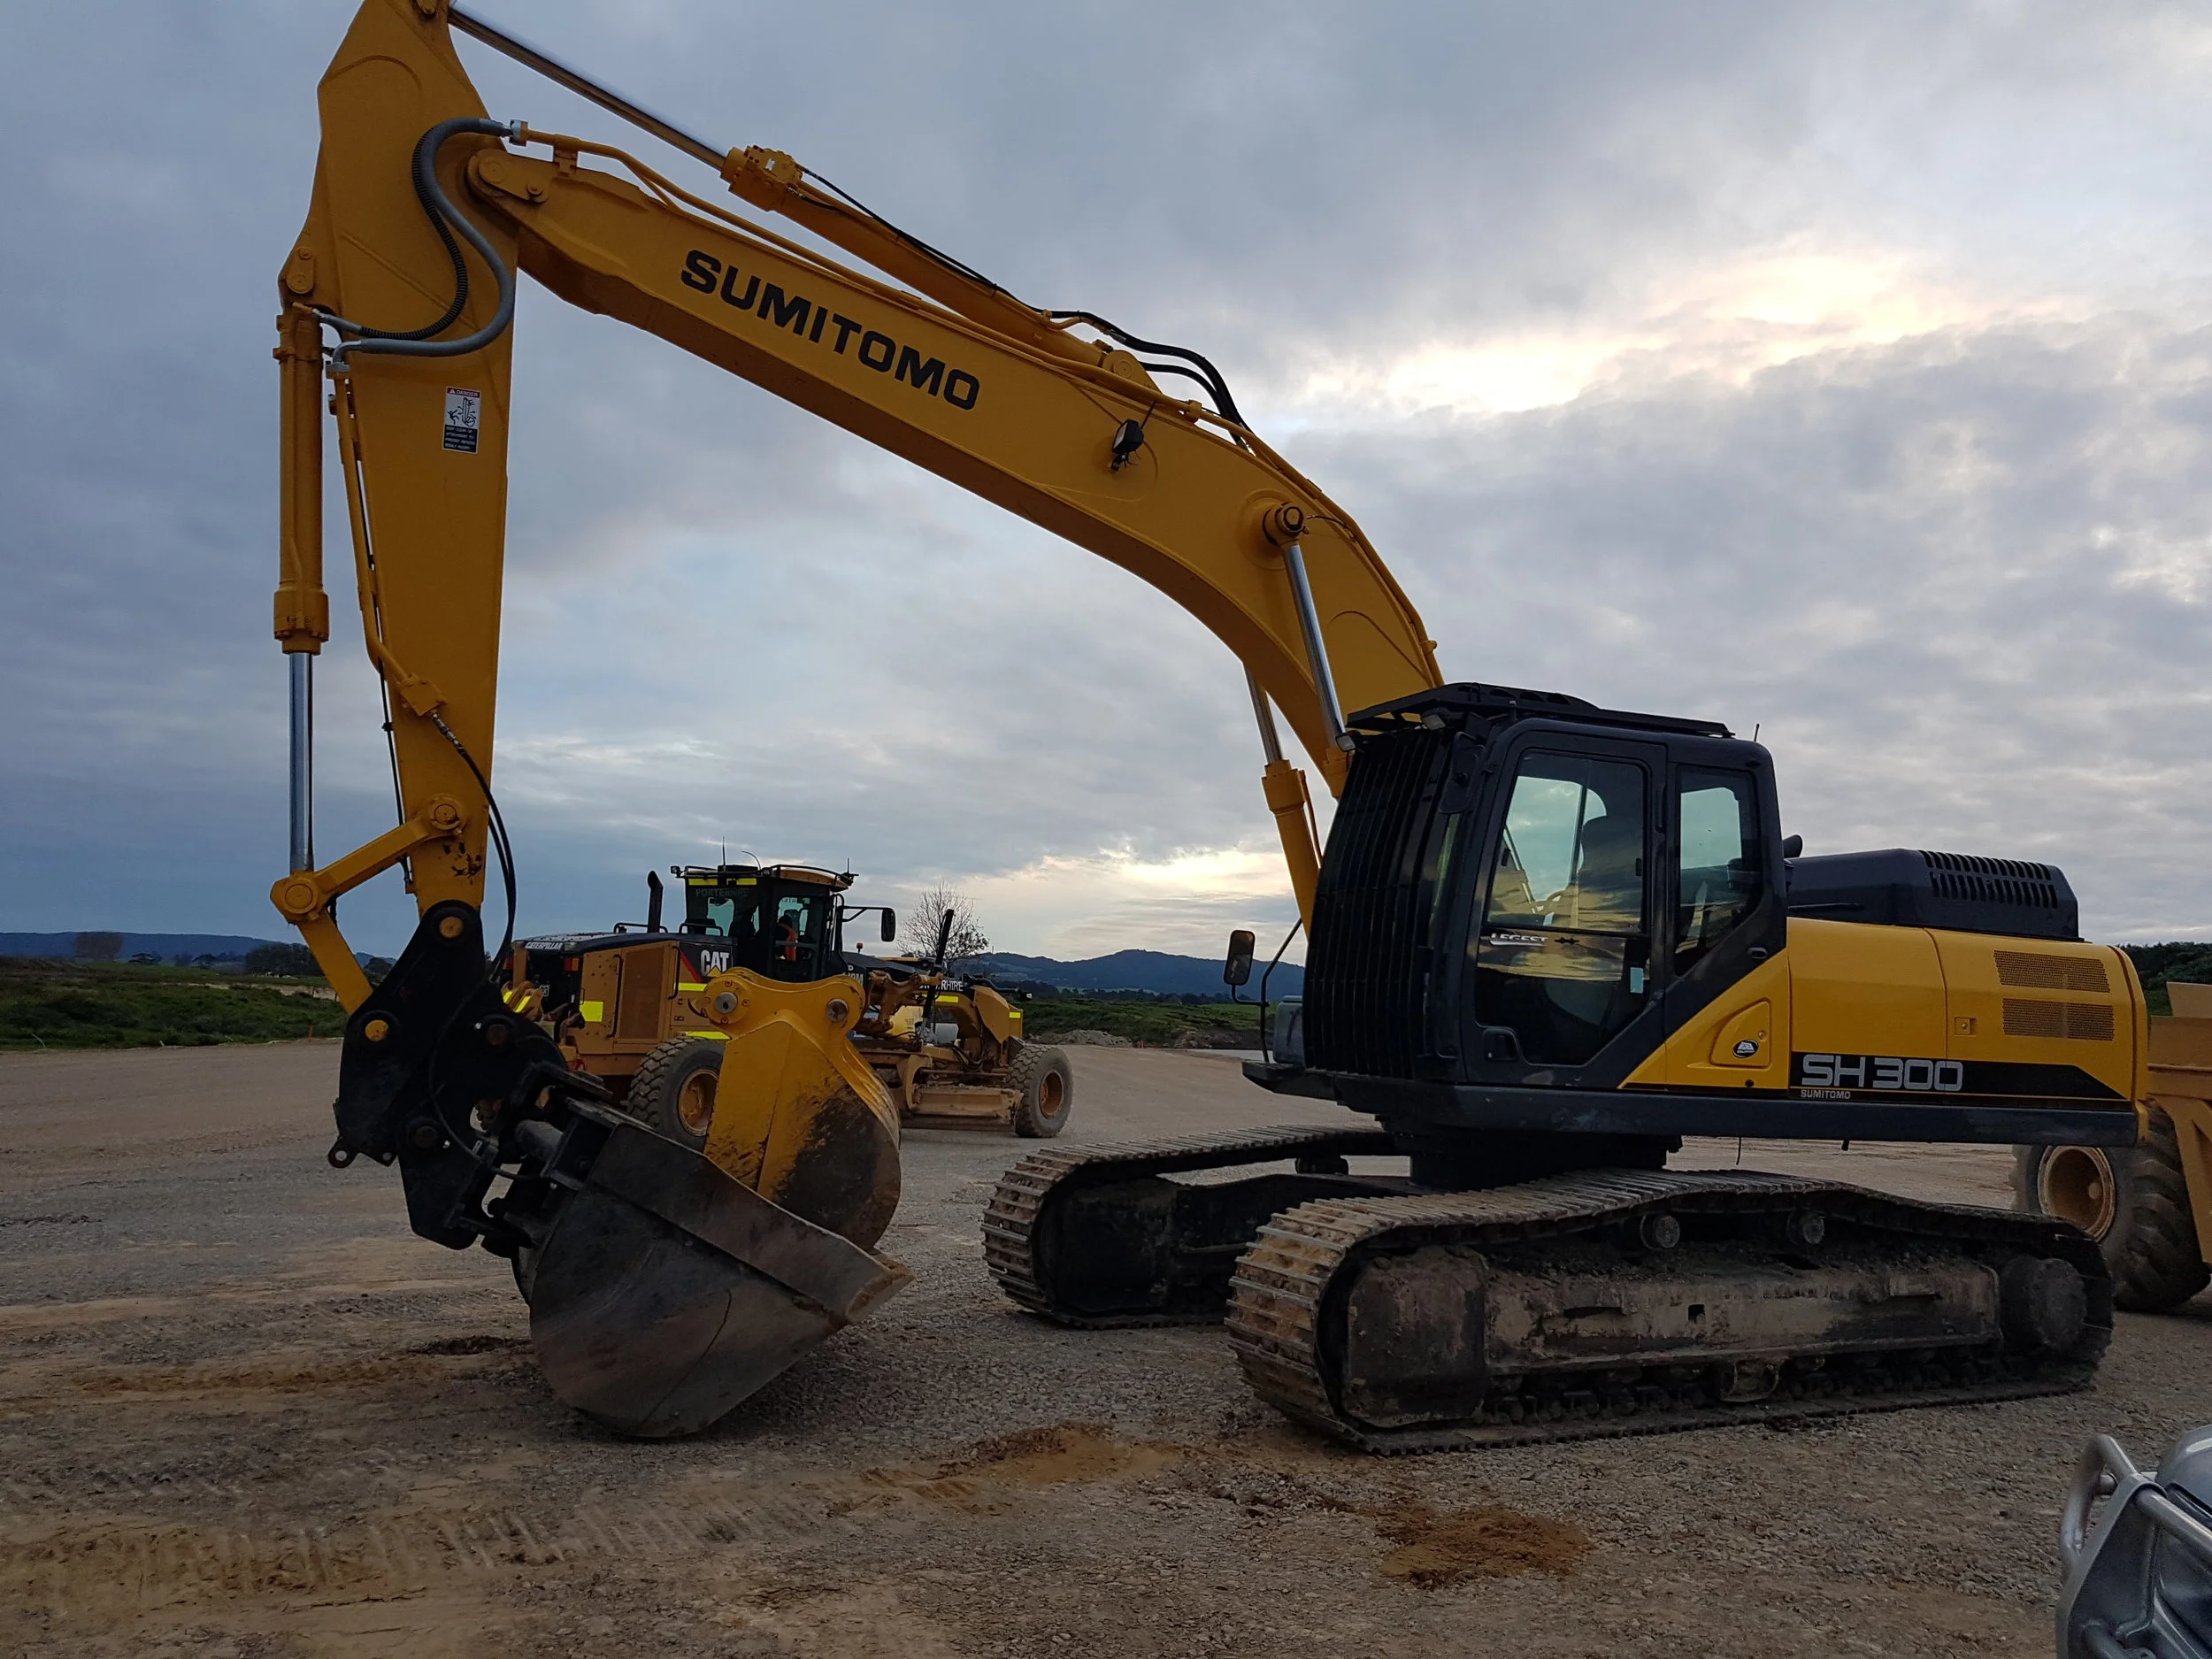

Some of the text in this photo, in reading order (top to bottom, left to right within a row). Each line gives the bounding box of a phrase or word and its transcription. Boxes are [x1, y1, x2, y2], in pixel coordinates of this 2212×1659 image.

[680, 249, 980, 411] SUMITOMO
[700, 949, 730, 977] CAT
[1801, 1089, 1851, 1100] SUMITOMO
